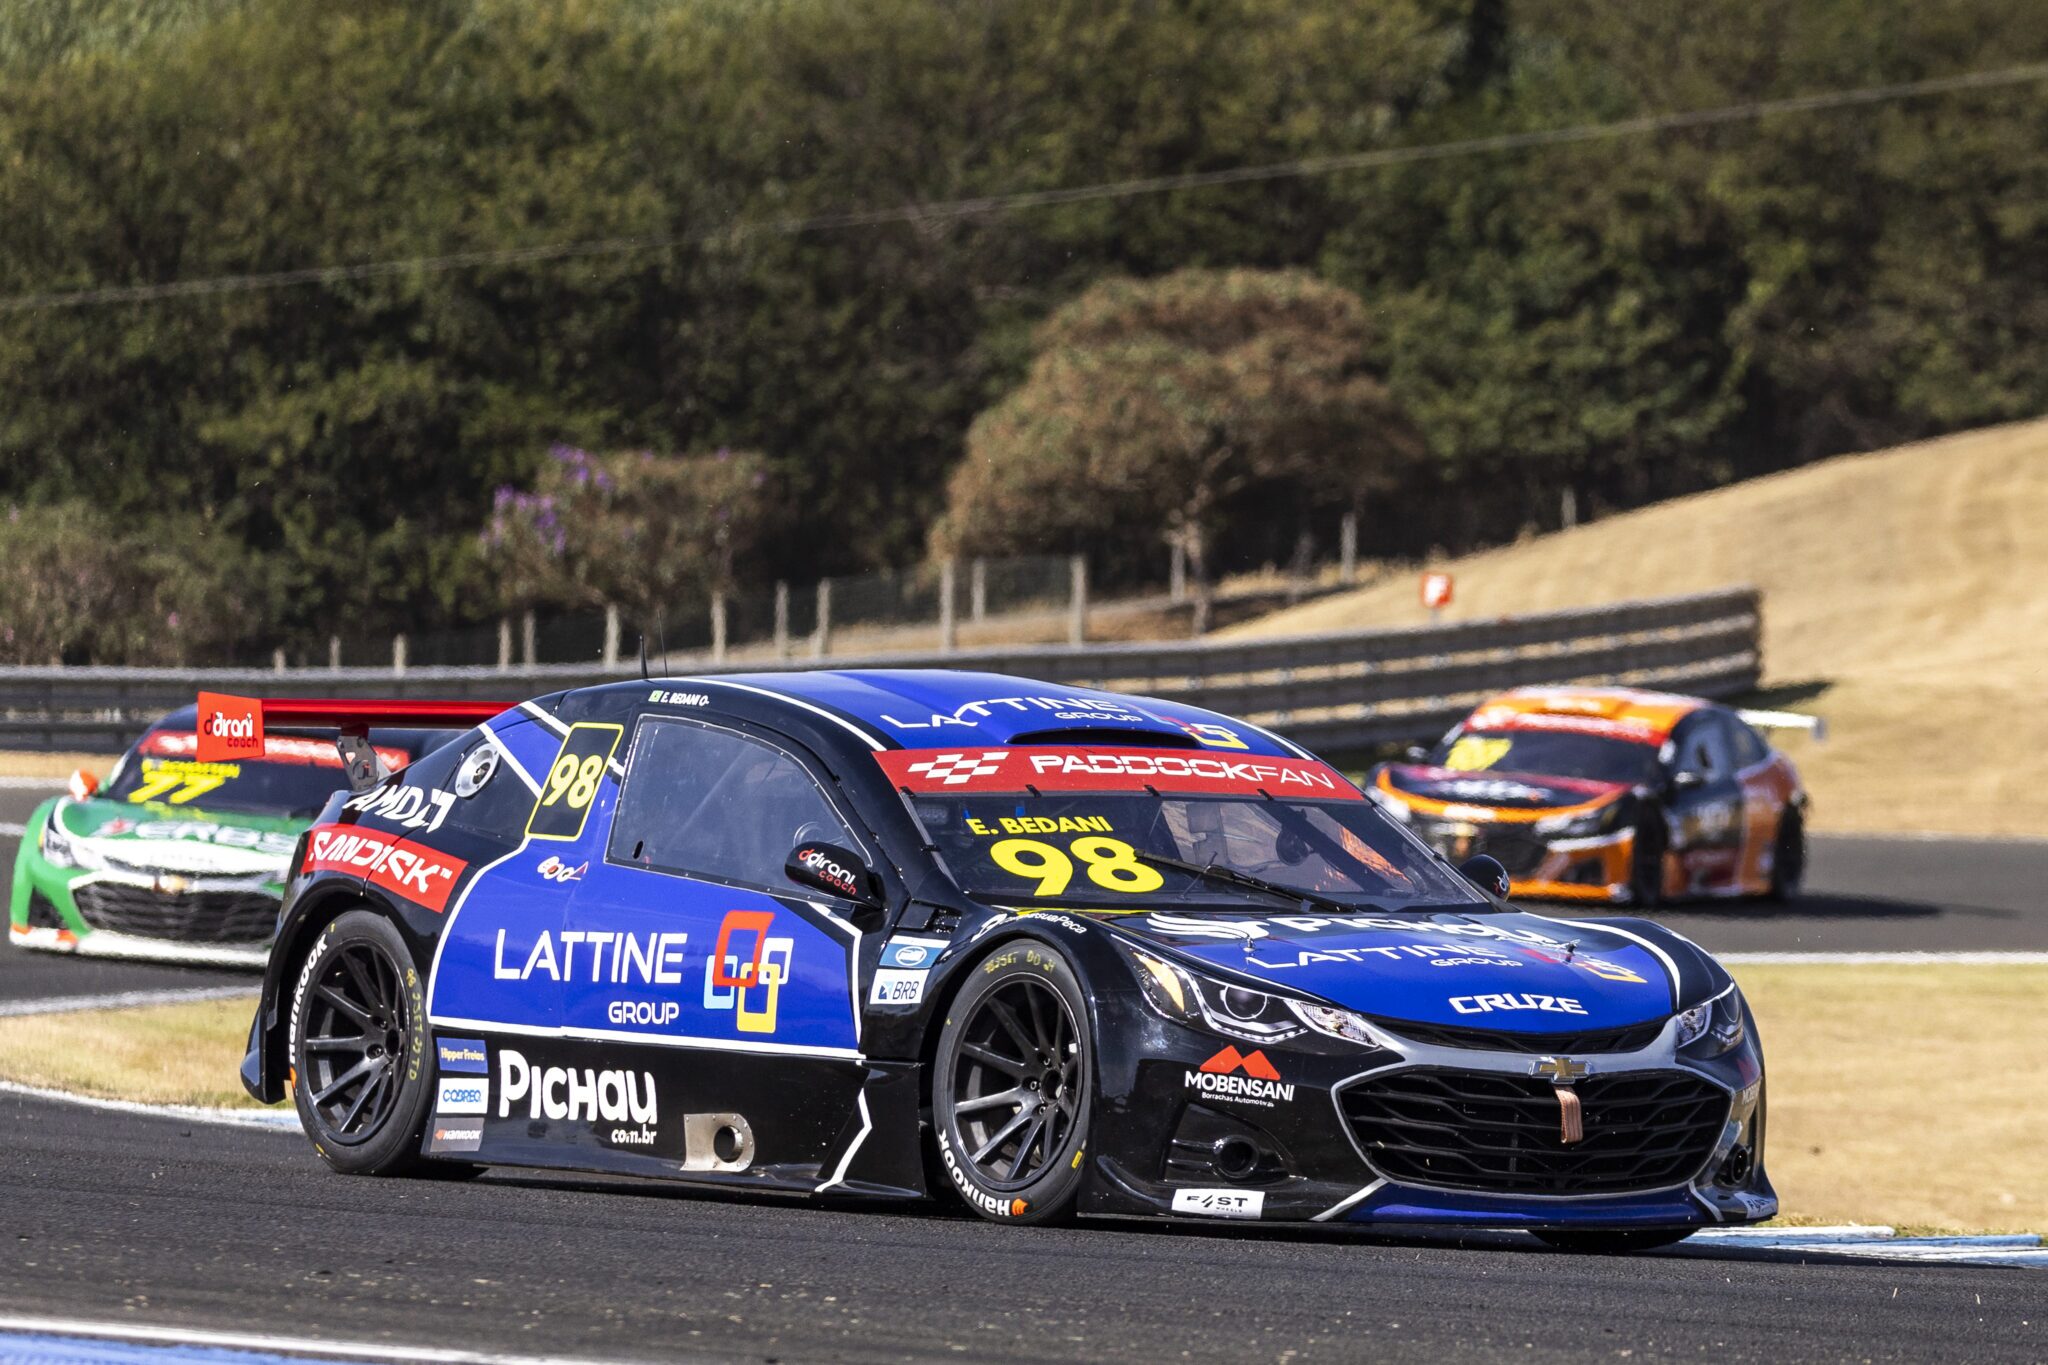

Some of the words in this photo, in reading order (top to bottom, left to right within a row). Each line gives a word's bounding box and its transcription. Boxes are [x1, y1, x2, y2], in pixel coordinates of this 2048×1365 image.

[1054, 712, 1143, 723] GROUP
[227, 735, 259, 748] coach
[127, 770, 227, 804] 77
[541, 753, 604, 809] 98
[341, 784, 425, 821] AMD
[965, 818, 999, 836] E.
[1005, 815, 1115, 835] BEDANI
[989, 835, 1164, 897] 98
[818, 870, 857, 896] coach
[494, 928, 688, 984] LATTINE
[1430, 957, 1523, 968] GROUP
[892, 981, 920, 1000] BRB
[608, 1001, 680, 1024] GROUP
[1449, 993, 1589, 1015] CRUZE
[1184, 1070, 1295, 1102] MOBENSANI
[1201, 1091, 1234, 1102] Borrachas
[611, 1124, 657, 1145] com.br
